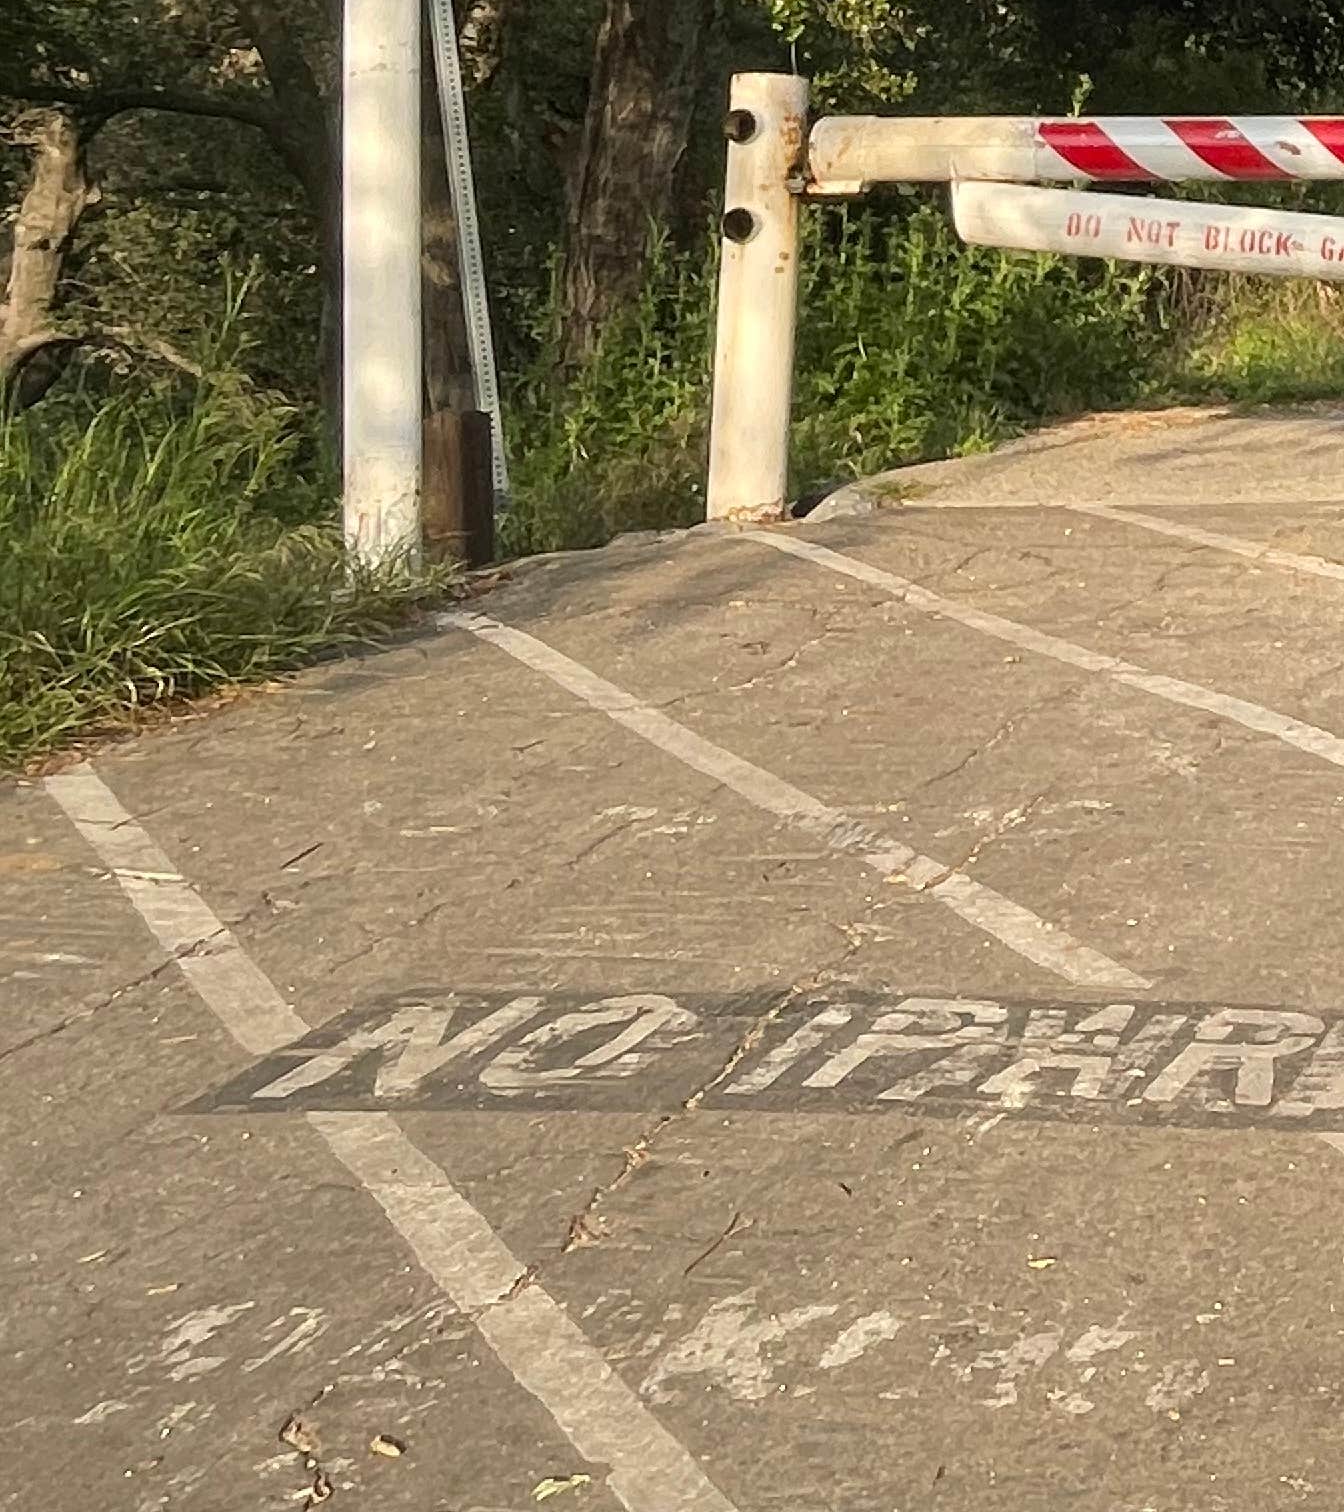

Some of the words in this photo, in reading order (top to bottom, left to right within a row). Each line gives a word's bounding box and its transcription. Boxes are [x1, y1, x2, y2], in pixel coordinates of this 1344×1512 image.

[1065, 212, 1101, 238] DO
[1127, 216, 1180, 248] NOT
[1204, 225, 1294, 257] BLOCK
[249, 992, 700, 1098] NO
